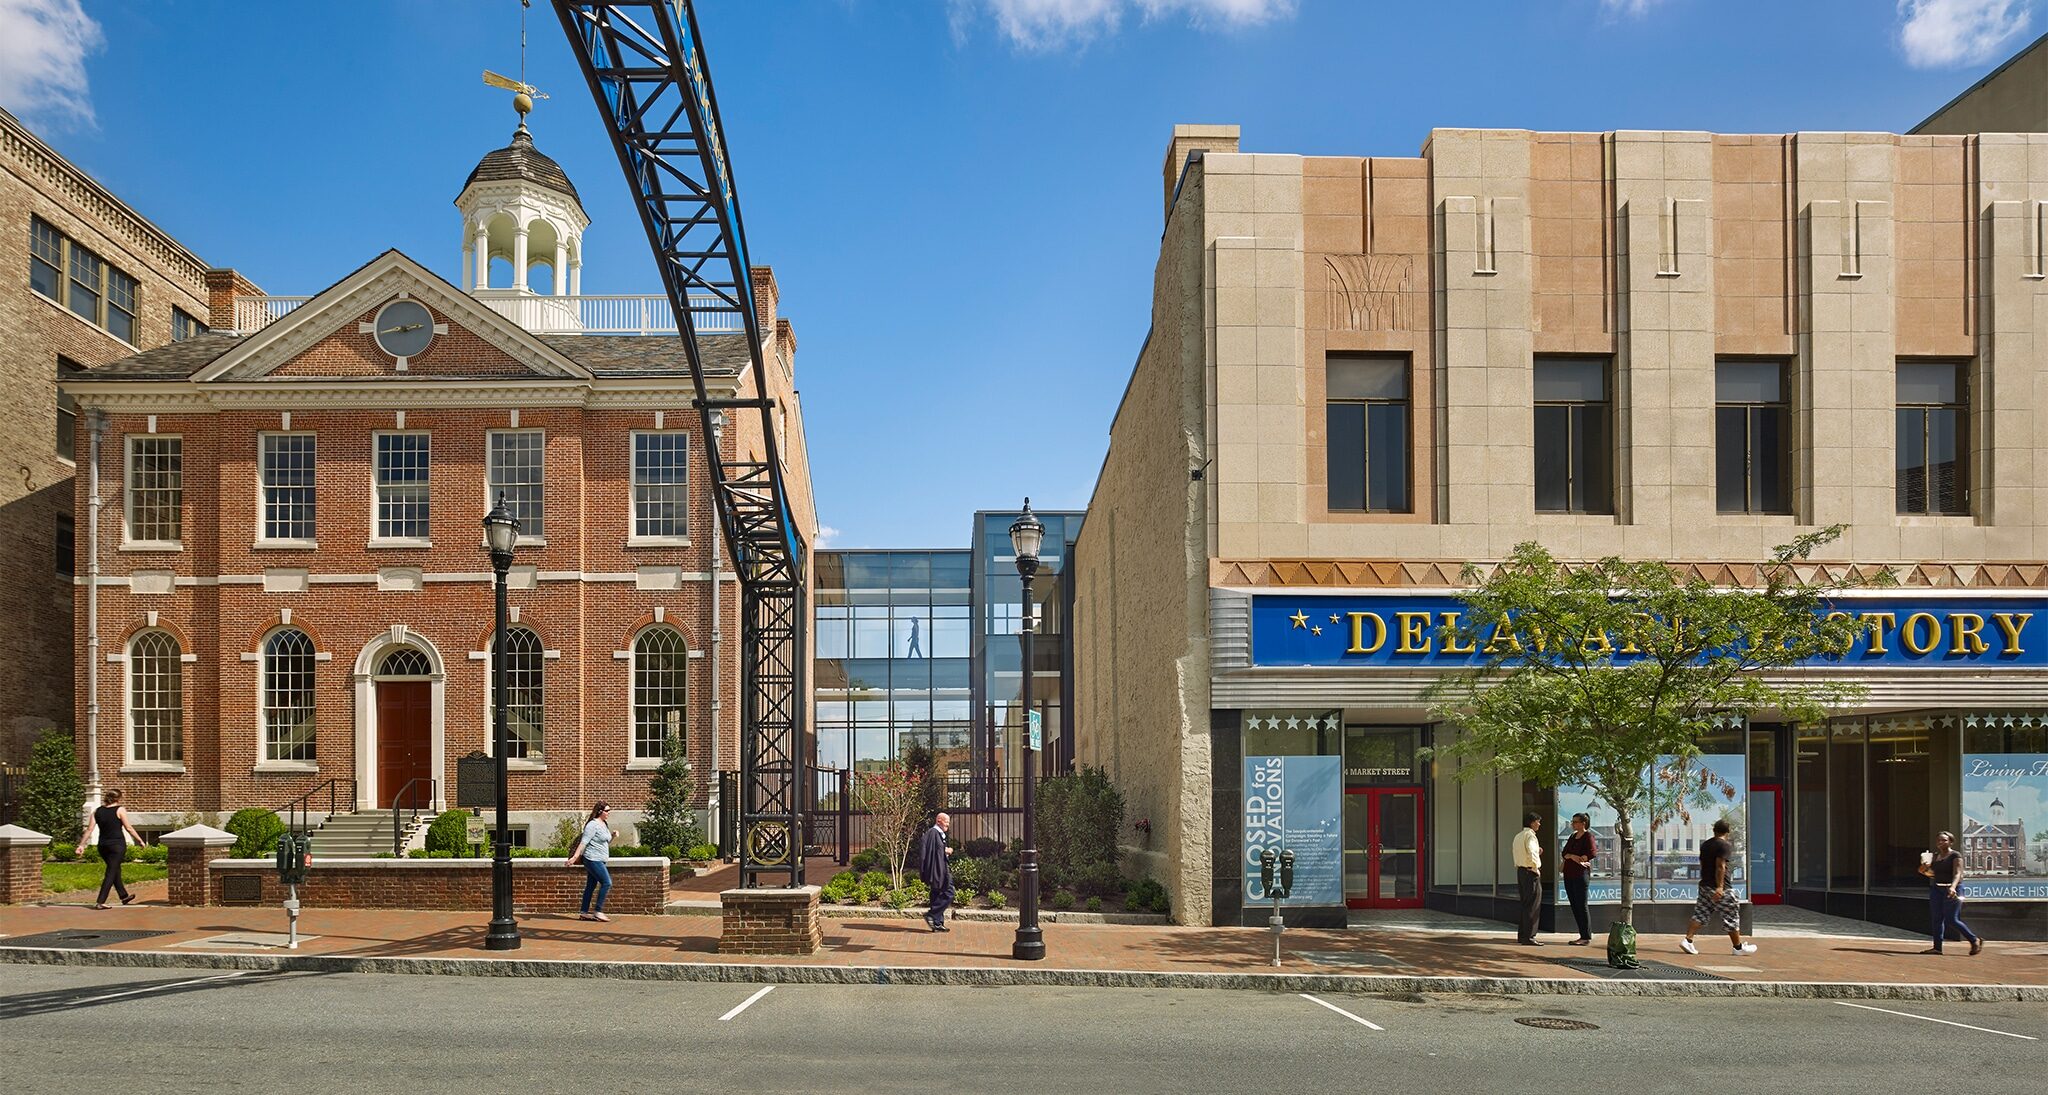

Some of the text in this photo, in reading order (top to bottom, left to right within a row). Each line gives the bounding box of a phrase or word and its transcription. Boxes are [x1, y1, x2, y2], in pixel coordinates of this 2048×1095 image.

[1749, 611, 2034, 655] STORY
[1251, 764, 1266, 788] for
[1350, 767, 1381, 776] MARKET
[1382, 767, 1411, 776] STREET
[1964, 758, 2026, 790] Living
[1266, 757, 1282, 899] ENOVATIONS
[1559, 888, 1622, 900] DWARE
[1627, 887, 1694, 900] ISTORICAL
[1964, 886, 2025, 897] DELAWARE
